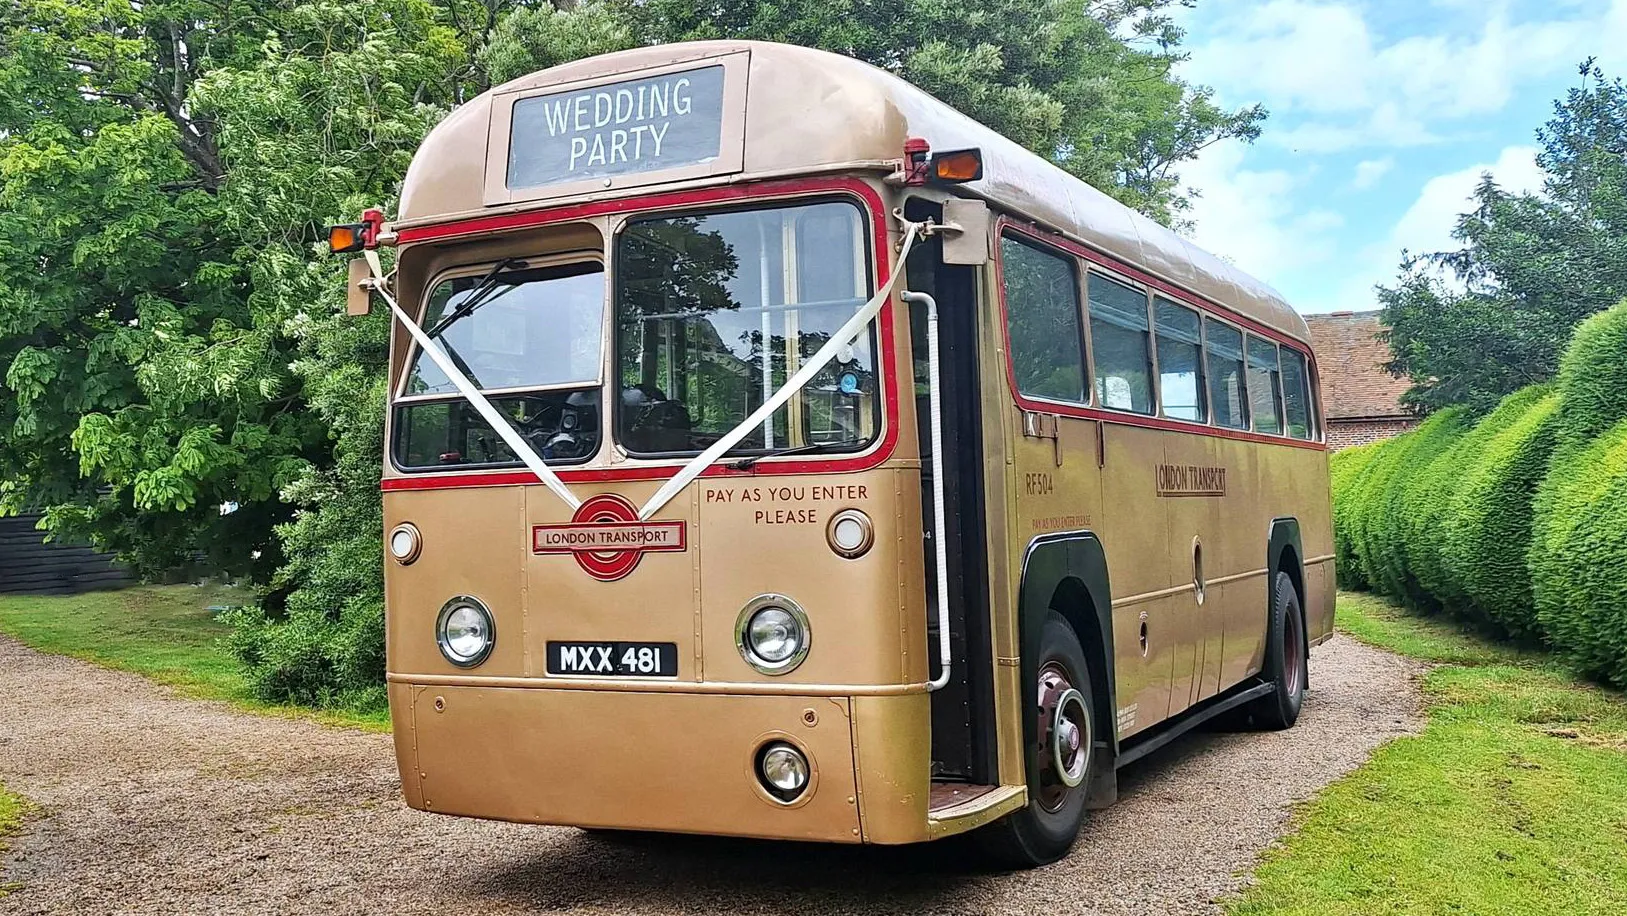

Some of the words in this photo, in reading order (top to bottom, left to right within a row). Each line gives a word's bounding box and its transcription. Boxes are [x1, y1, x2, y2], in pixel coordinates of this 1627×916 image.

[544, 78, 692, 137] WEDDING
[569, 121, 670, 171] PARTY
[1026, 473, 1053, 495] RF504
[1154, 464, 1187, 497] LONDON
[1188, 466, 1226, 497] TRANSPORT
[706, 489, 735, 503] PAY
[741, 488, 761, 502] AS
[768, 486, 805, 501] YOU
[812, 485, 869, 500] ENTER
[755, 509, 817, 524] PLEASE
[546, 533, 596, 544] LONDON
[599, 531, 669, 543] TRANSPORT
[560, 646, 613, 672] MXX
[621, 647, 661, 673] 481
